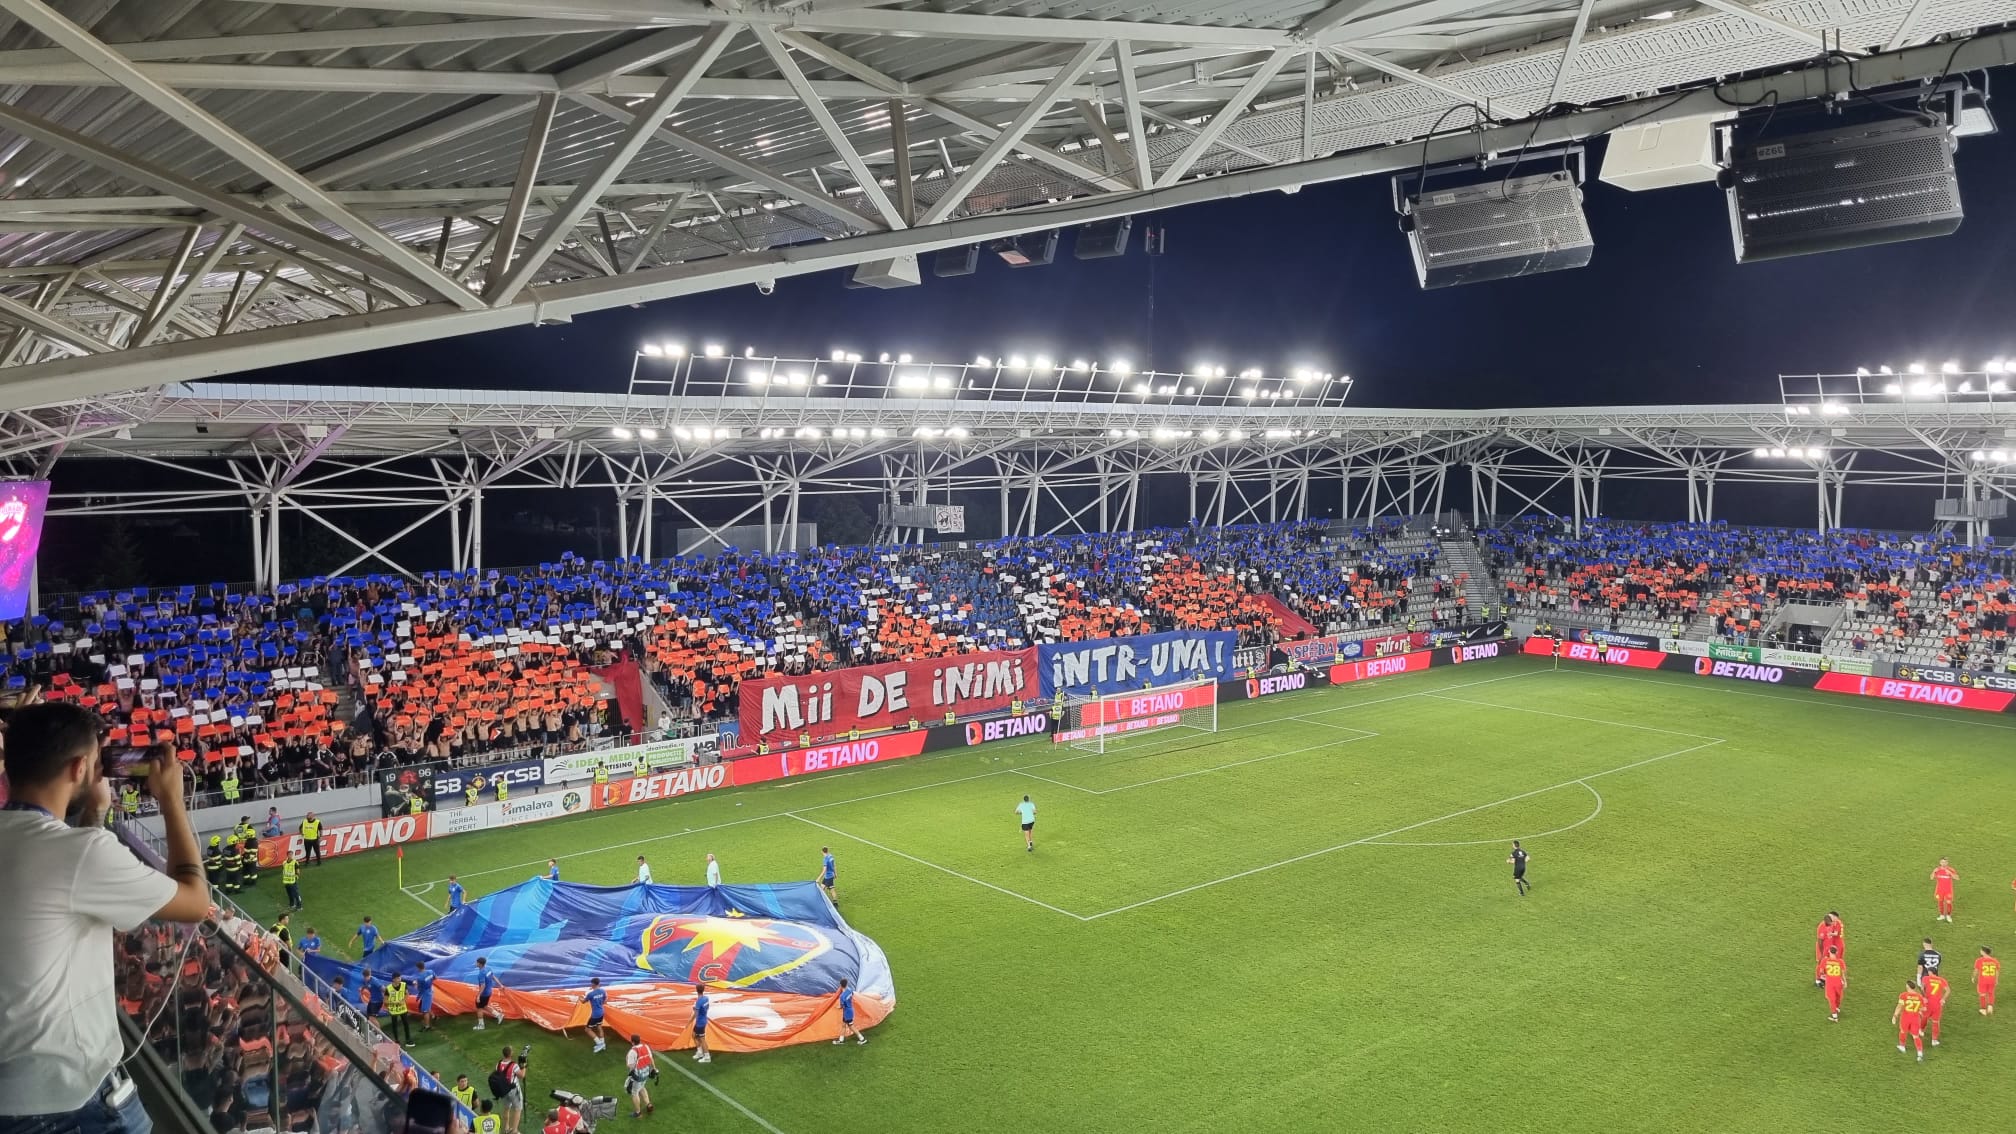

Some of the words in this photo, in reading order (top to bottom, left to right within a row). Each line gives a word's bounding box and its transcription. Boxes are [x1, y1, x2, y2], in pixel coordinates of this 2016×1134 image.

[1462, 643, 1498, 661] BETANO
[1367, 657, 1406, 677] BETANO
[1713, 660, 1783, 683] BETANO
[1260, 673, 1305, 695] BETANO
[1881, 680, 1964, 704] BETANO
[857, 671, 909, 717] DE
[1131, 692, 1184, 715] BETANO
[984, 713, 1046, 741] BETANO
[609, 751, 643, 763] MEDIA
[804, 740, 879, 771] BETANO
[586, 761, 633, 773] ADRTISING
[629, 765, 726, 802] BETANO
[449, 816, 478, 825] HERBAL
[449, 823, 477, 833] EXPERT
[1825, 964, 1841, 977] 28
[1924, 957, 1939, 969] 32
[1982, 965, 1997, 977] 25
[1930, 982, 1940, 995] 7
[1905, 999, 1921, 1013] 27
